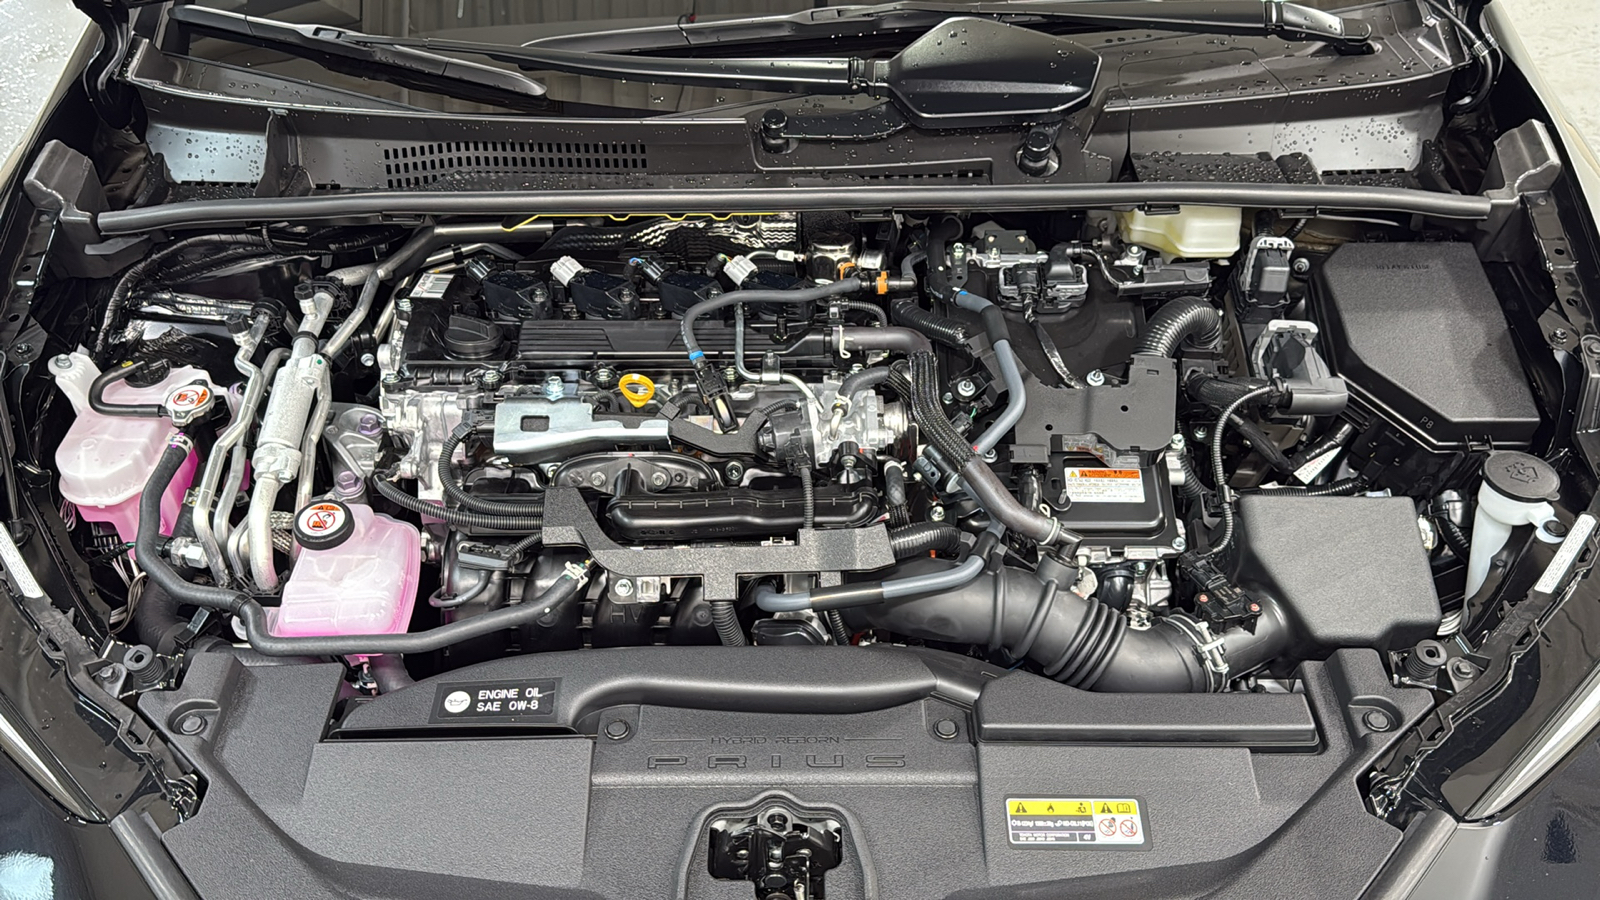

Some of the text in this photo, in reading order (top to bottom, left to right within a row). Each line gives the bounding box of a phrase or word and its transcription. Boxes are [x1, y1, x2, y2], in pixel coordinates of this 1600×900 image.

[478, 687, 543, 700] ENGINE OIL
[476, 700, 539, 712] SAE 0W-8
[711, 736, 840, 744] HYBRID REBORN
[647, 753, 906, 769] PRIUS
